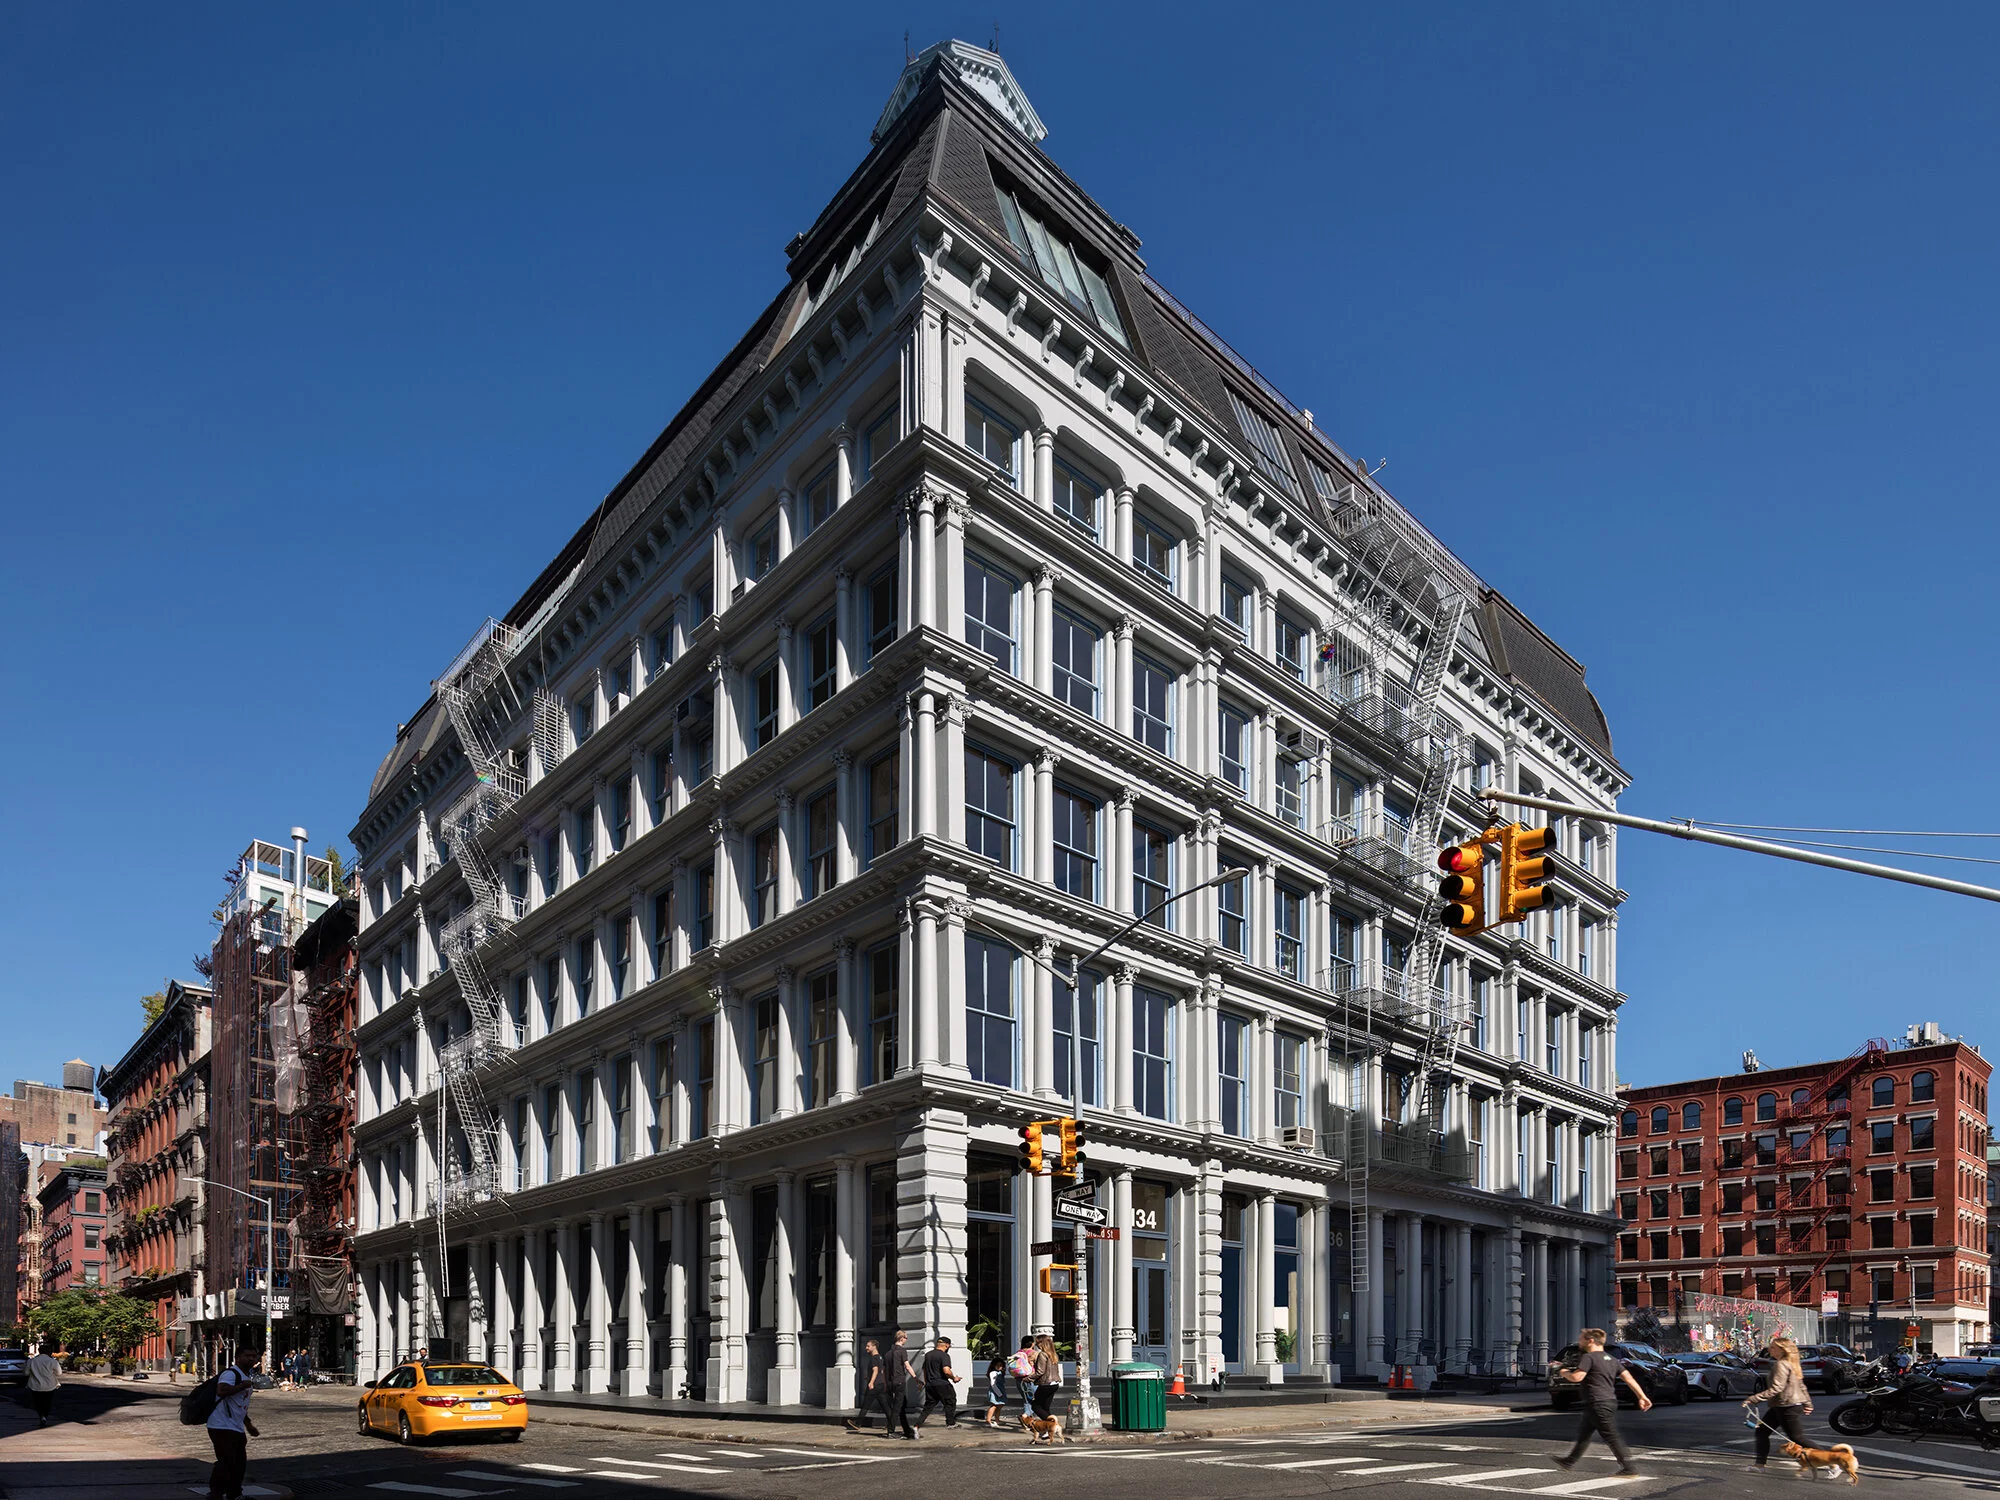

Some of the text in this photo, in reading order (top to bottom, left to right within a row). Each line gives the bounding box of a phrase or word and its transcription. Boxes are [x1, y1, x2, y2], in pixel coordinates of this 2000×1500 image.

[1075, 1186, 1090, 1196] WAY
[1065, 1205, 1101, 1219] ONE WAY
[1131, 1207, 1157, 1229] 134
[1107, 1229, 1114, 1239] St
[1032, 1242, 1061, 1255] Crosby St
[261, 1302, 290, 1311] BRBER
